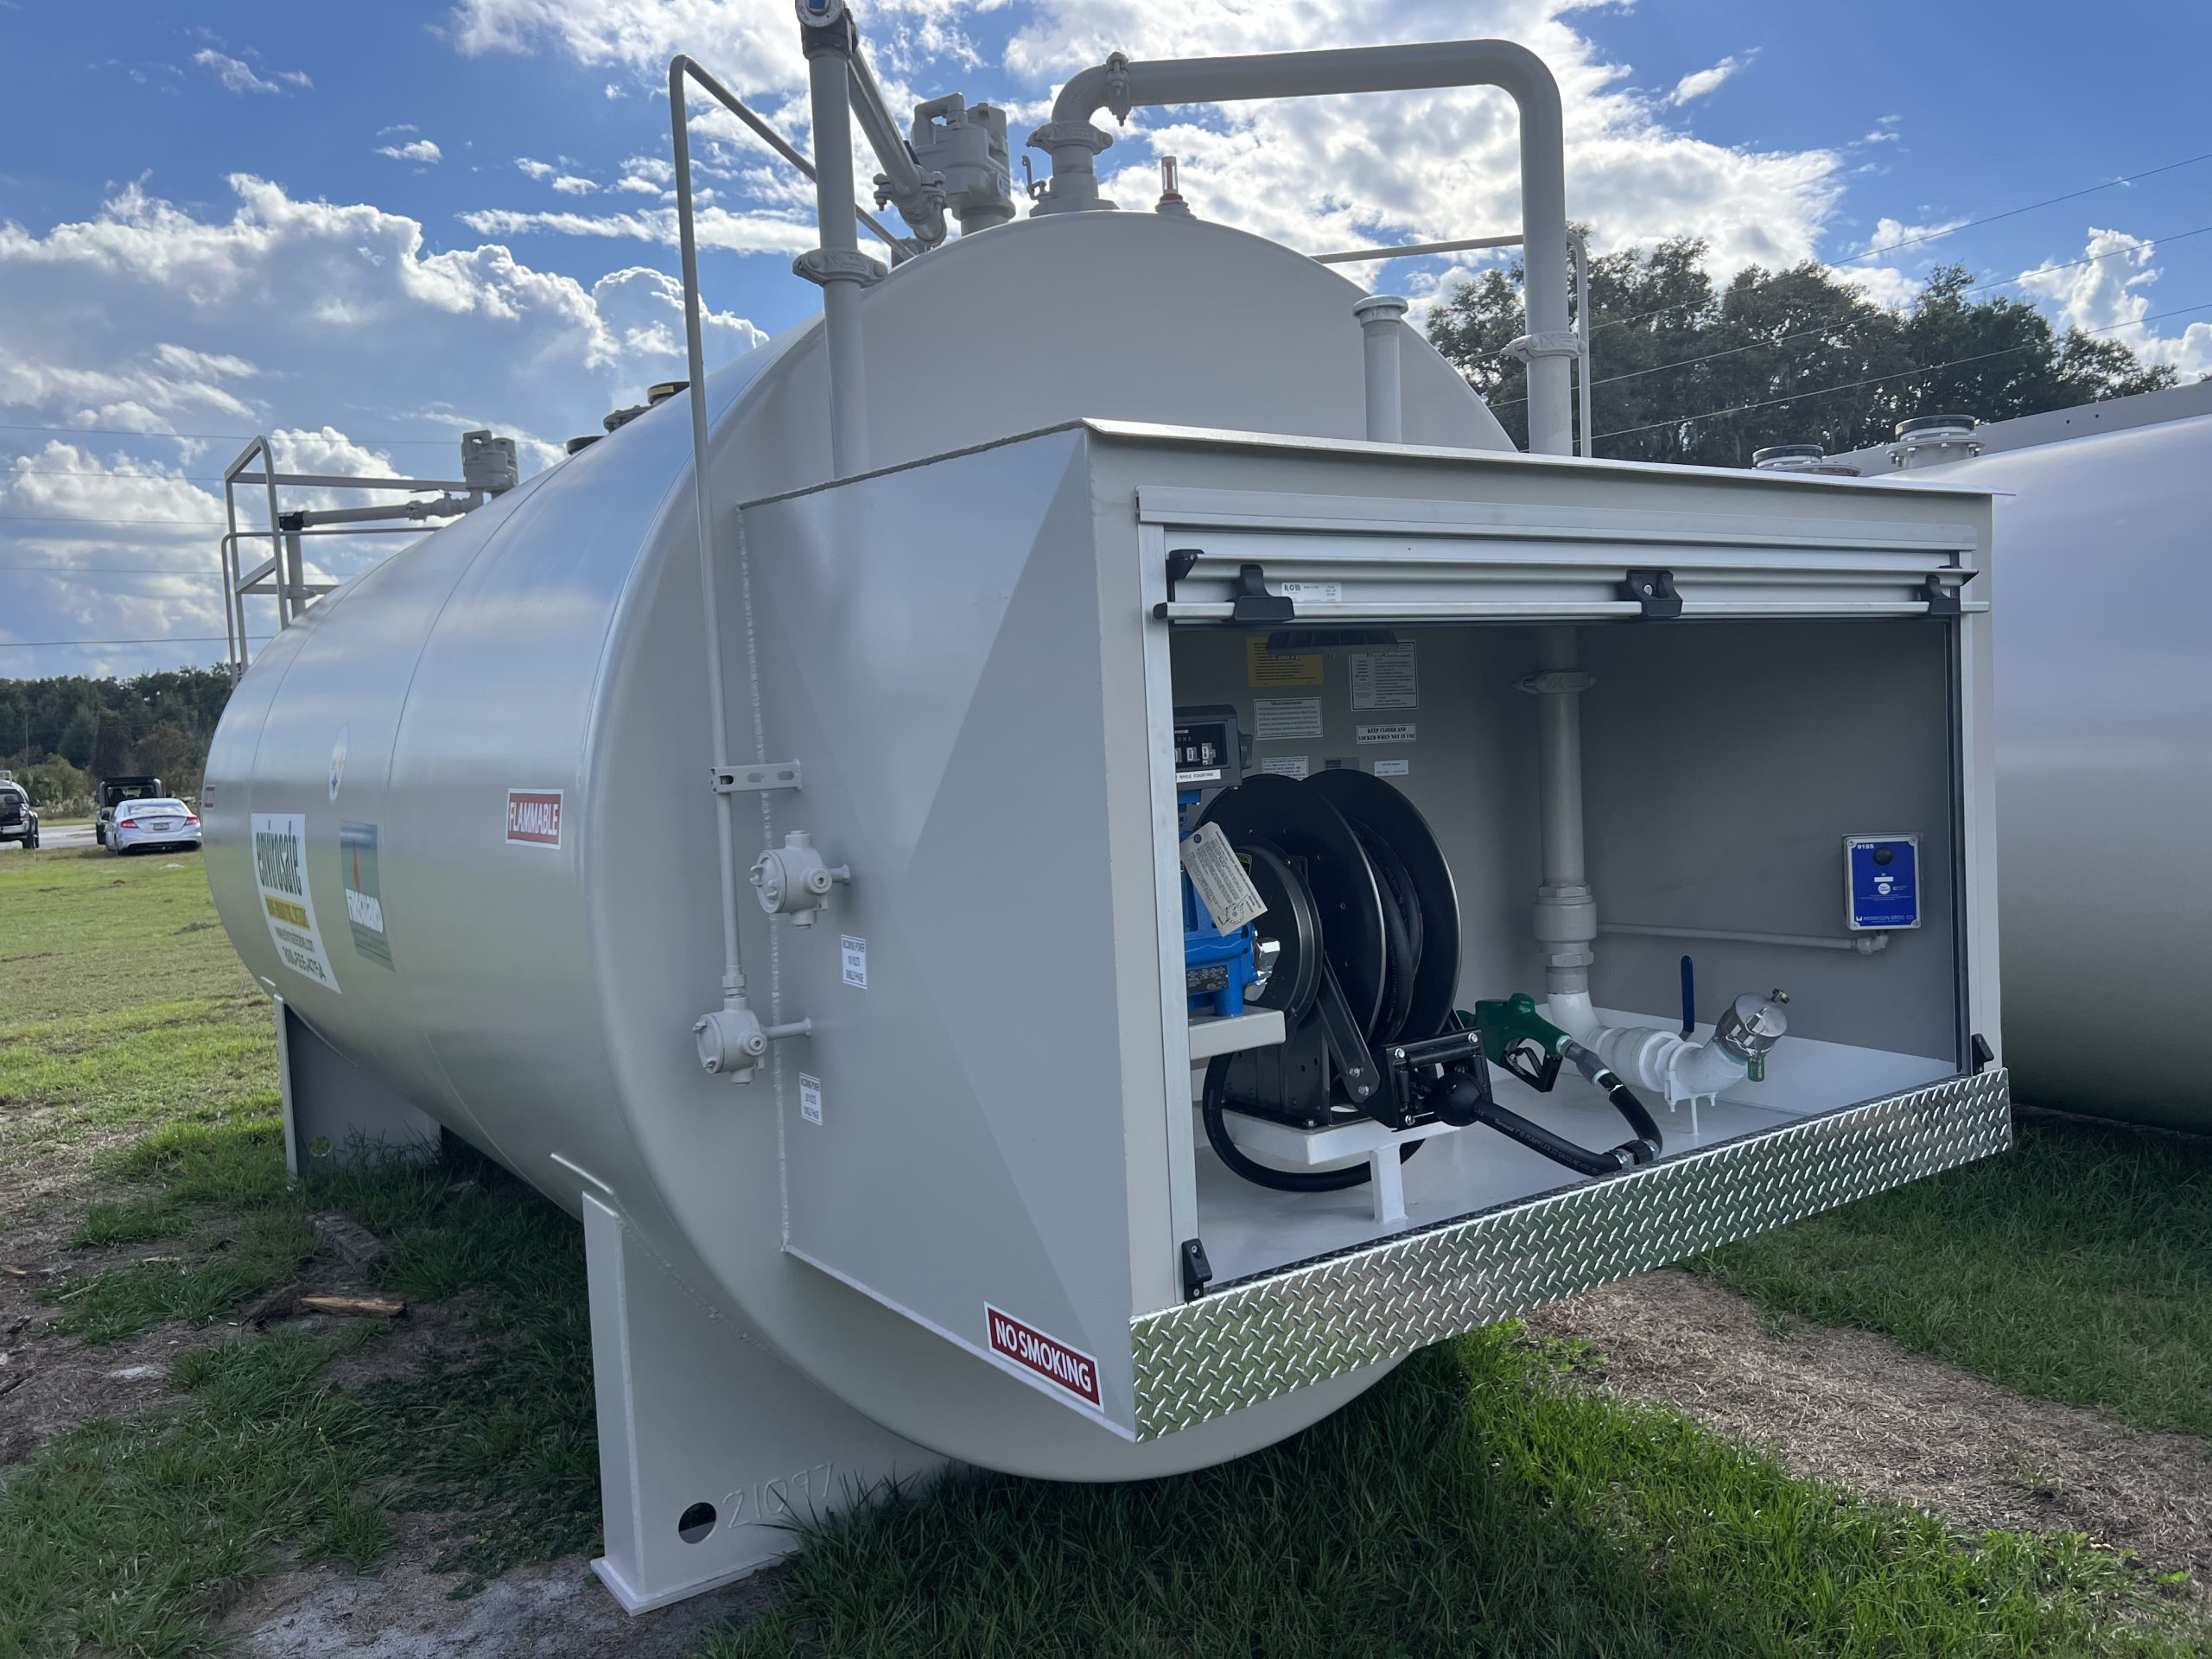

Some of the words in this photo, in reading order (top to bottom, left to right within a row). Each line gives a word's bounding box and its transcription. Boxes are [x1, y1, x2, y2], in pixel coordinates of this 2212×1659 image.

[509, 801, 559, 836] FLAMMABLE
[995, 1318, 1018, 1351] NO
[1018, 1330, 1092, 1393] SMOKING
